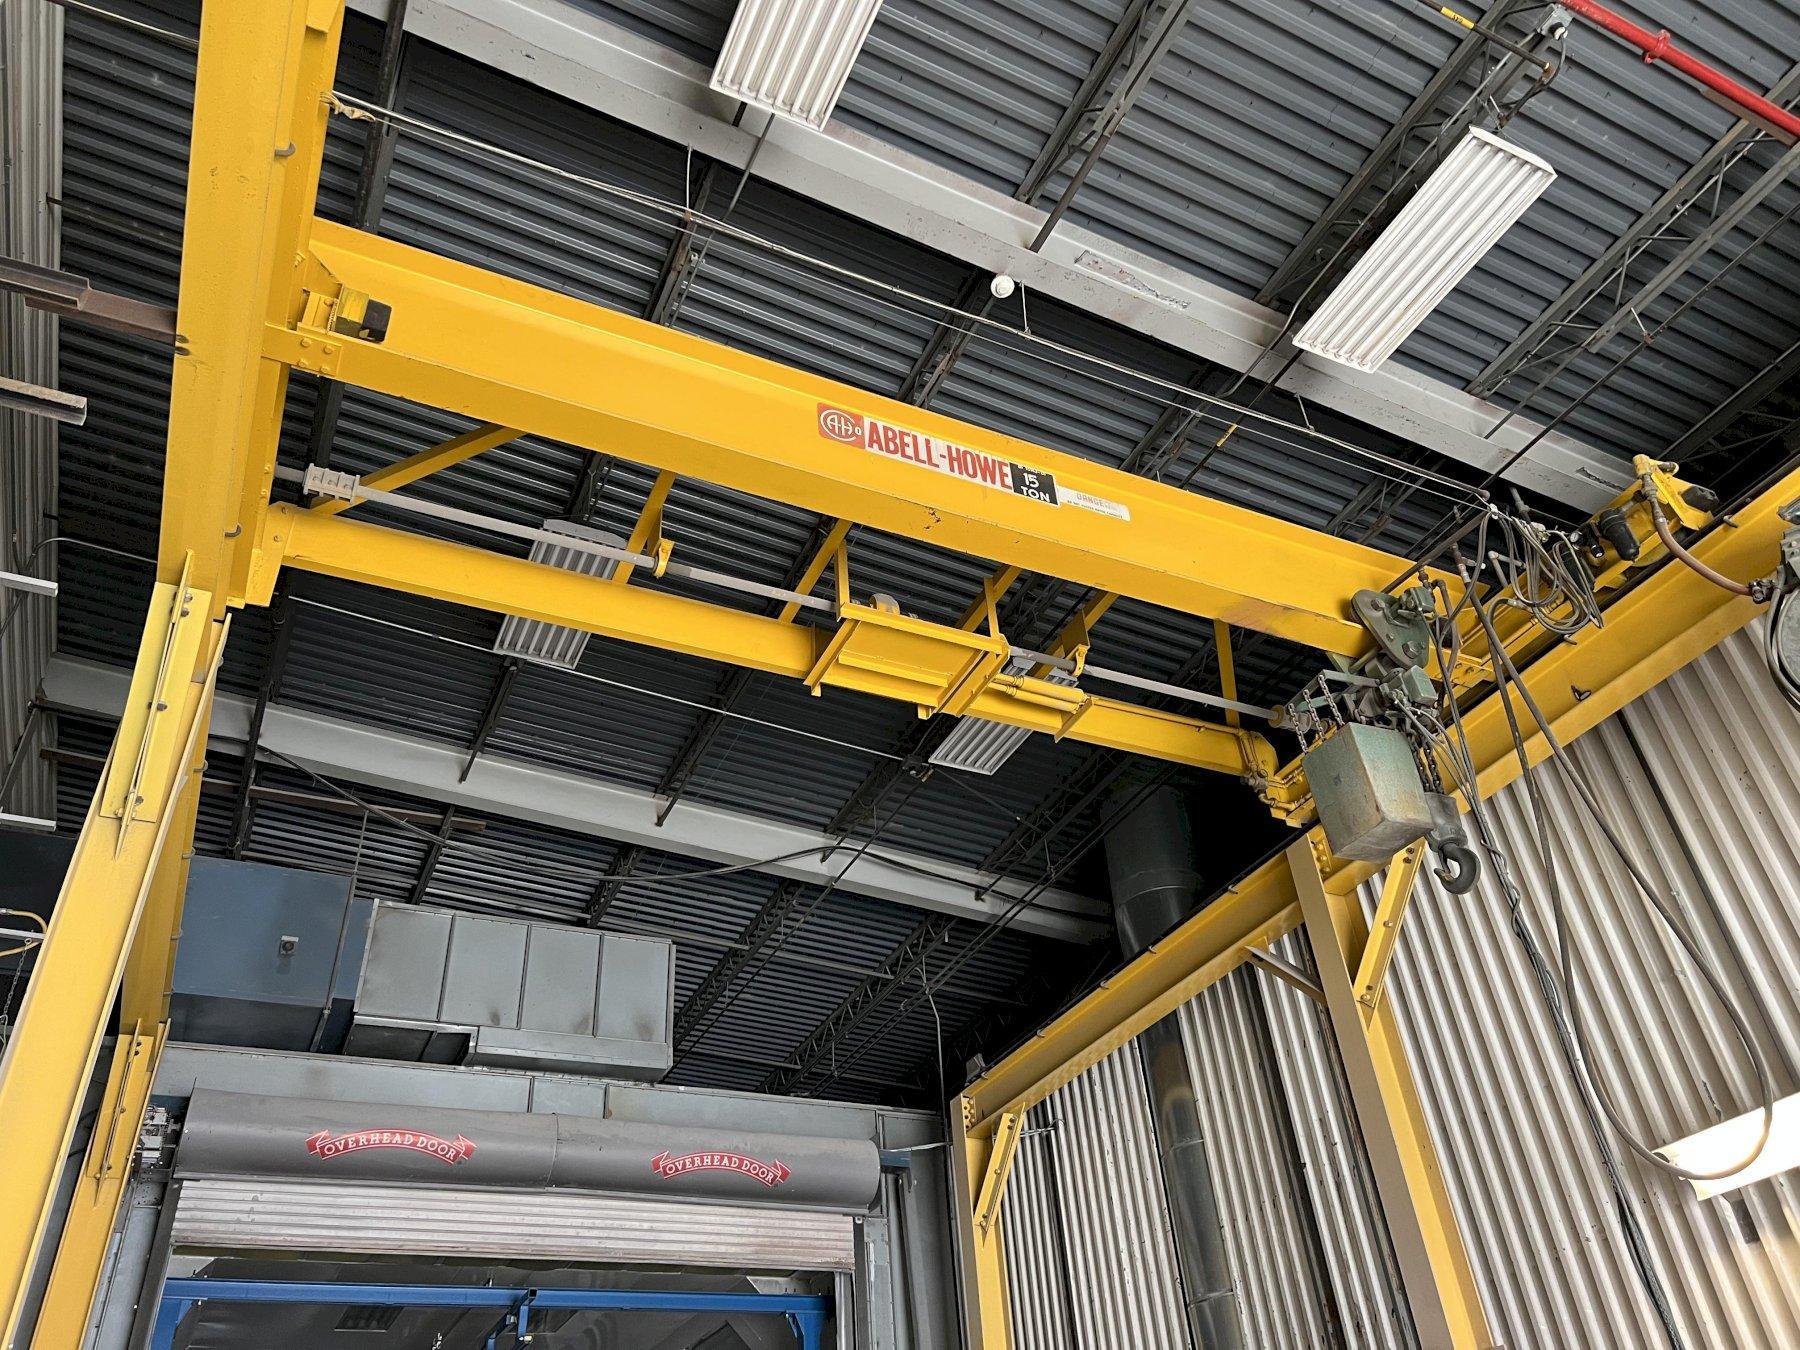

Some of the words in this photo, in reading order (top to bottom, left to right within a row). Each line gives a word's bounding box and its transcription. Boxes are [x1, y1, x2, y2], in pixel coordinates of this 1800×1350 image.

[867, 421, 1013, 490] ABELL-HOWE
[1021, 486, 1050, 503] TON
[1023, 473, 1040, 488] 15
[324, 1132, 414, 1155] OVERHEAD
[417, 1135, 457, 1160] DOOR
[666, 1155, 739, 1174] OVERHEAD
[742, 1160, 774, 1183] DOOR
